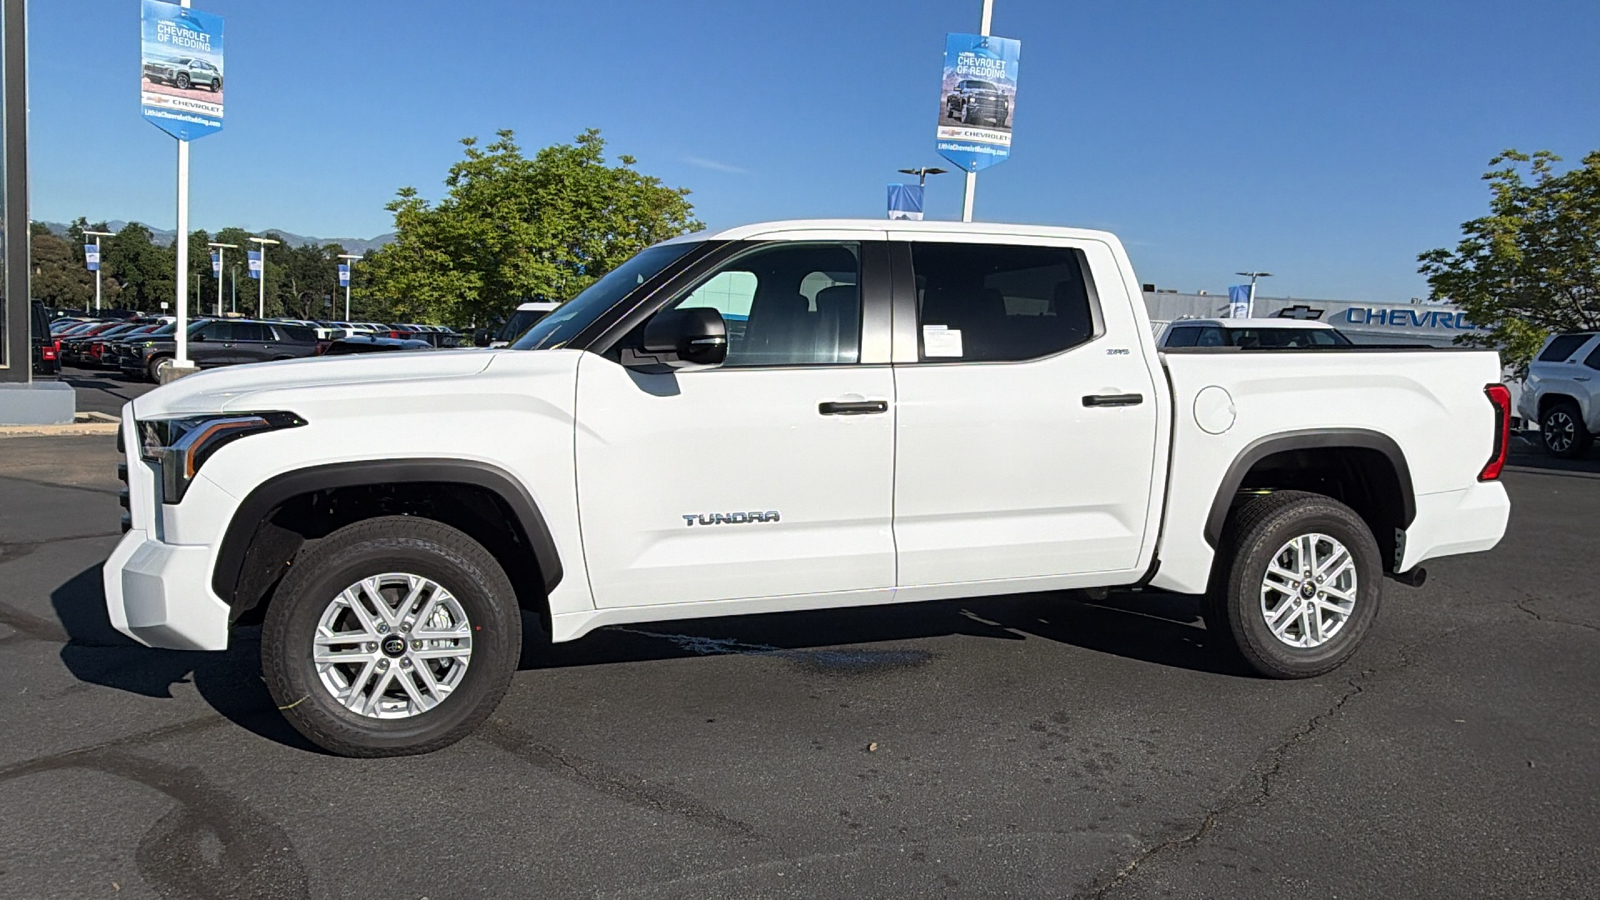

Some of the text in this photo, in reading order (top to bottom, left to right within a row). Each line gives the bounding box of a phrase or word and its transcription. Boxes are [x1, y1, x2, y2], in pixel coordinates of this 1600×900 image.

[157, 24, 211, 42] CHEVROLET
[157, 33, 211, 52] OF REDDING
[957, 56, 1006, 69] CHEVROLET
[956, 65, 1006, 79] OF REDDING
[172, 99, 220, 112] CHEVROLET
[964, 130, 1008, 141] CHEVROLET
[1346, 307, 1490, 331] CHEVRO
[682, 510, 780, 527] TUNDRA
